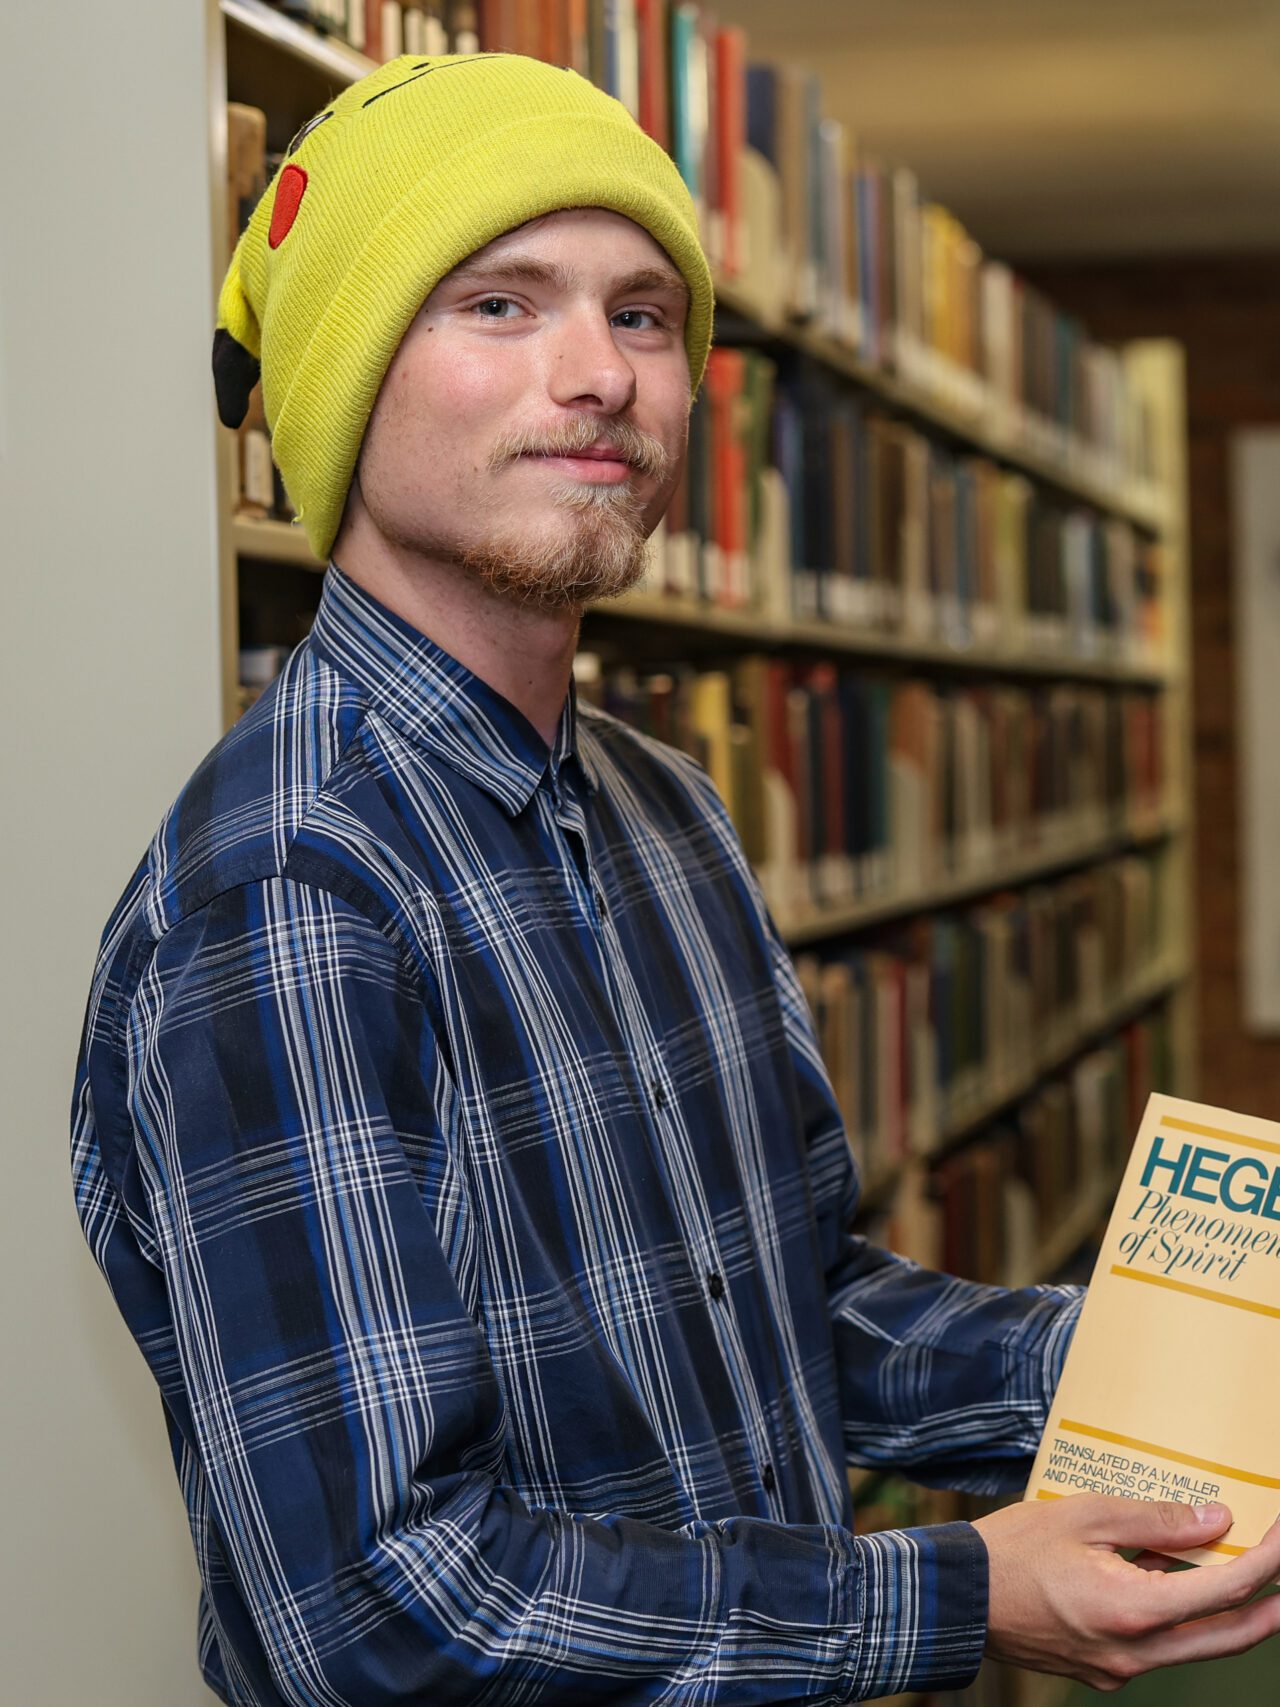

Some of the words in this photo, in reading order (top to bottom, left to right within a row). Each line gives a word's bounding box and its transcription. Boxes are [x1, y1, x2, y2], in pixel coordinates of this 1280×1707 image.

[1119, 1228, 1152, 1265] of
[1150, 1231, 1247, 1282] Spirit
[1042, 1468, 1068, 1483] AND
[1049, 1453, 1079, 1471] WITH
[1078, 1462, 1136, 1488] ANALYSIS
[1138, 1479, 1157, 1493] OF
[1159, 1485, 1185, 1504] THE
[1054, 1438, 1130, 1471] TRANSLATED
[1131, 1461, 1150, 1476] BY
[1172, 1474, 1220, 1498] MILLER
